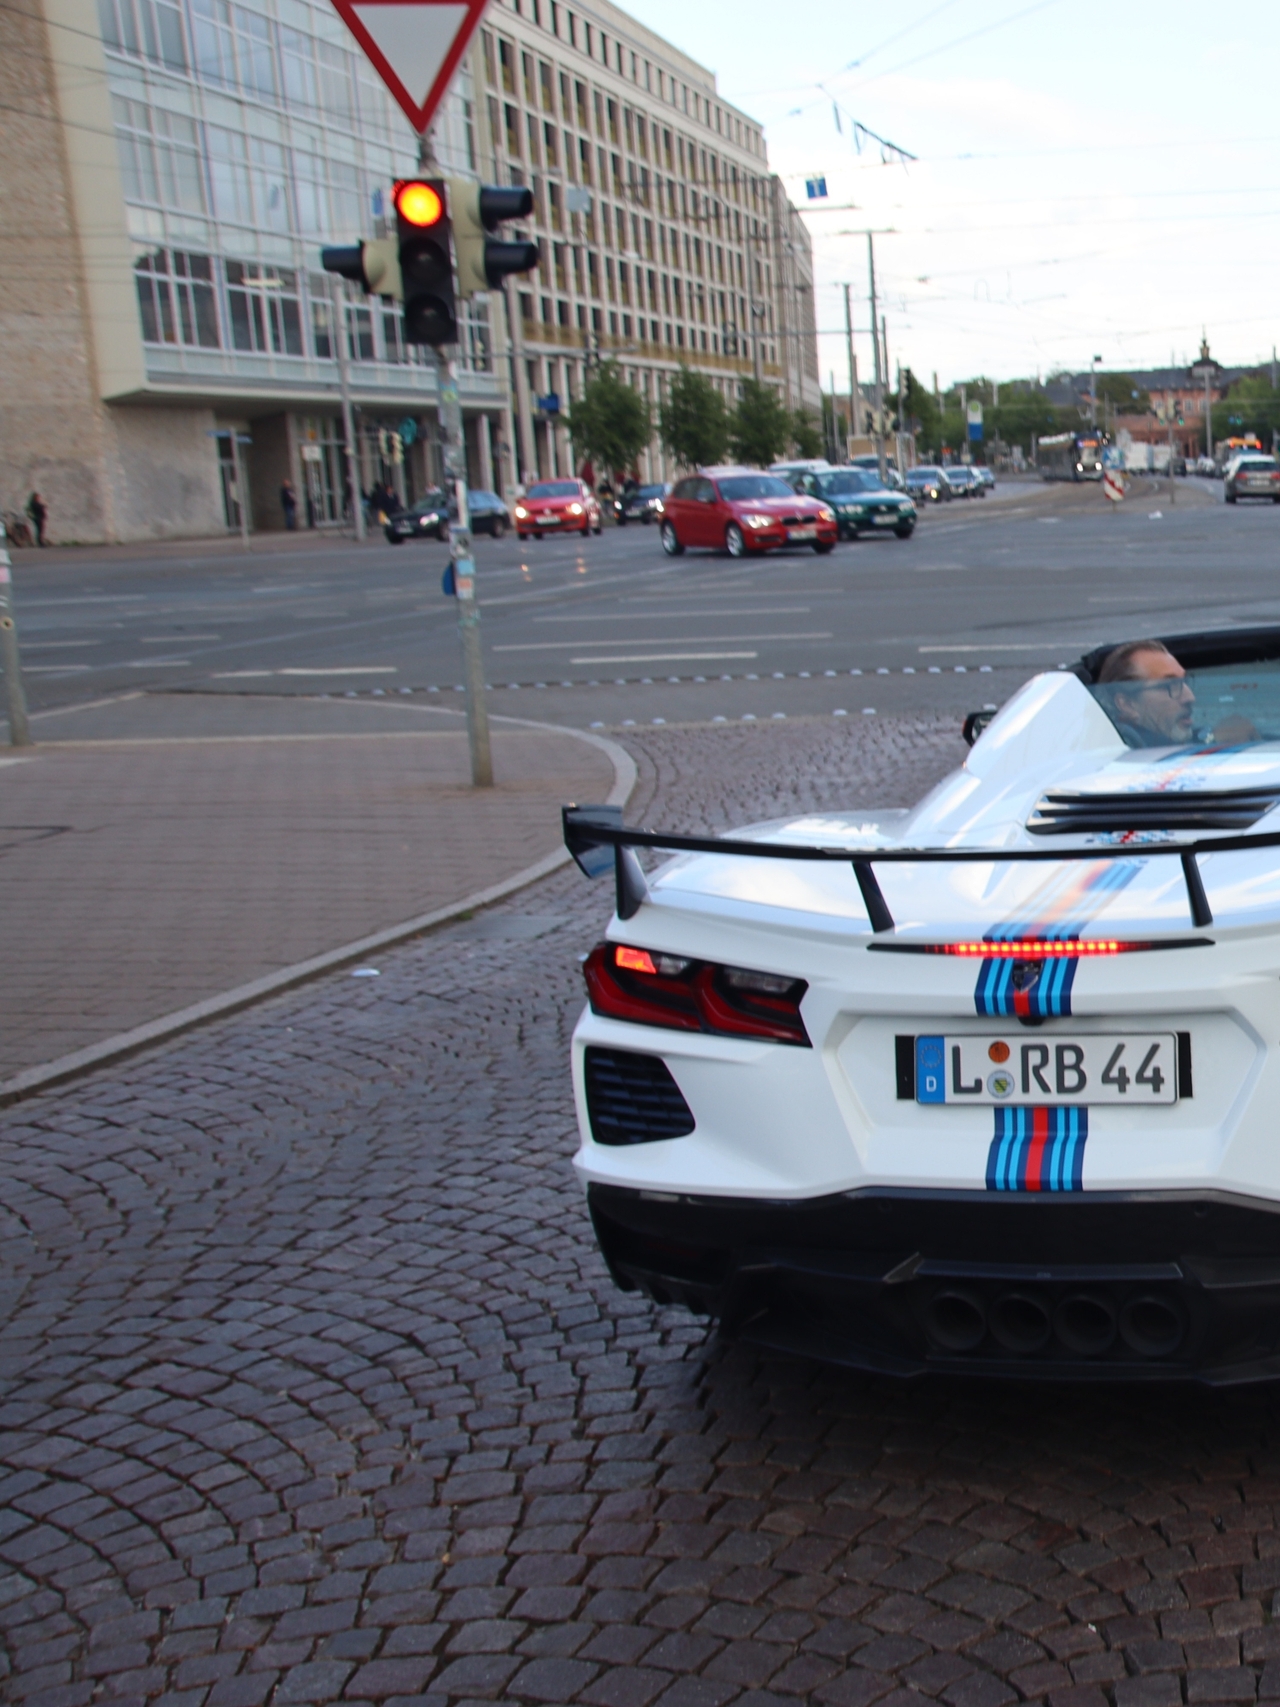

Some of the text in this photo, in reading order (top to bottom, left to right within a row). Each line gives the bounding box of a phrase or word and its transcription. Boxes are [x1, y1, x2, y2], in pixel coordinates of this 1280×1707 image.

[925, 1075, 937, 1093] D
[952, 1042, 1165, 1094] L RB 44
